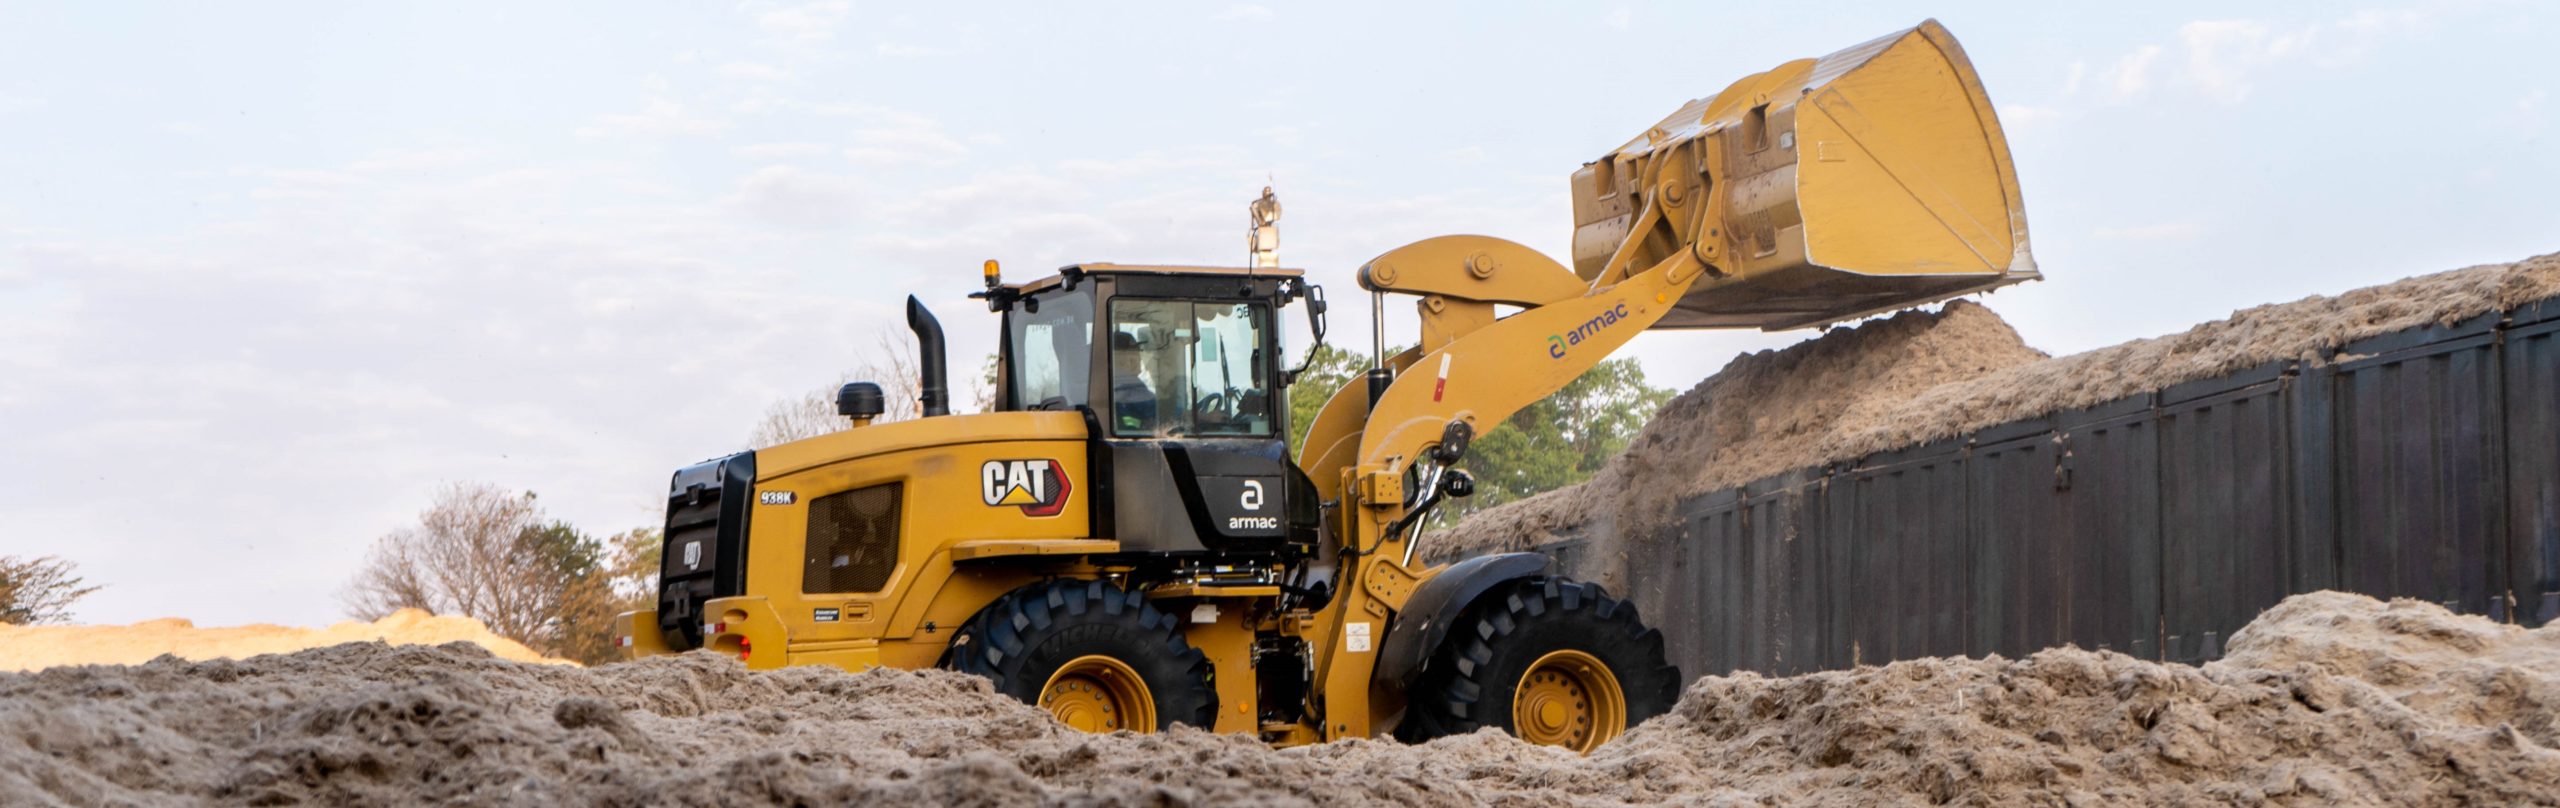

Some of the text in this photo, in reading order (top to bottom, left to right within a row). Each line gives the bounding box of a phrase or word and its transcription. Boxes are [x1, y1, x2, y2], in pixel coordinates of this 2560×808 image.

[1567, 304, 1628, 346] armac
[983, 460, 1049, 505] CAT
[761, 491, 792, 505] 938K
[1229, 517, 1277, 529] armac
